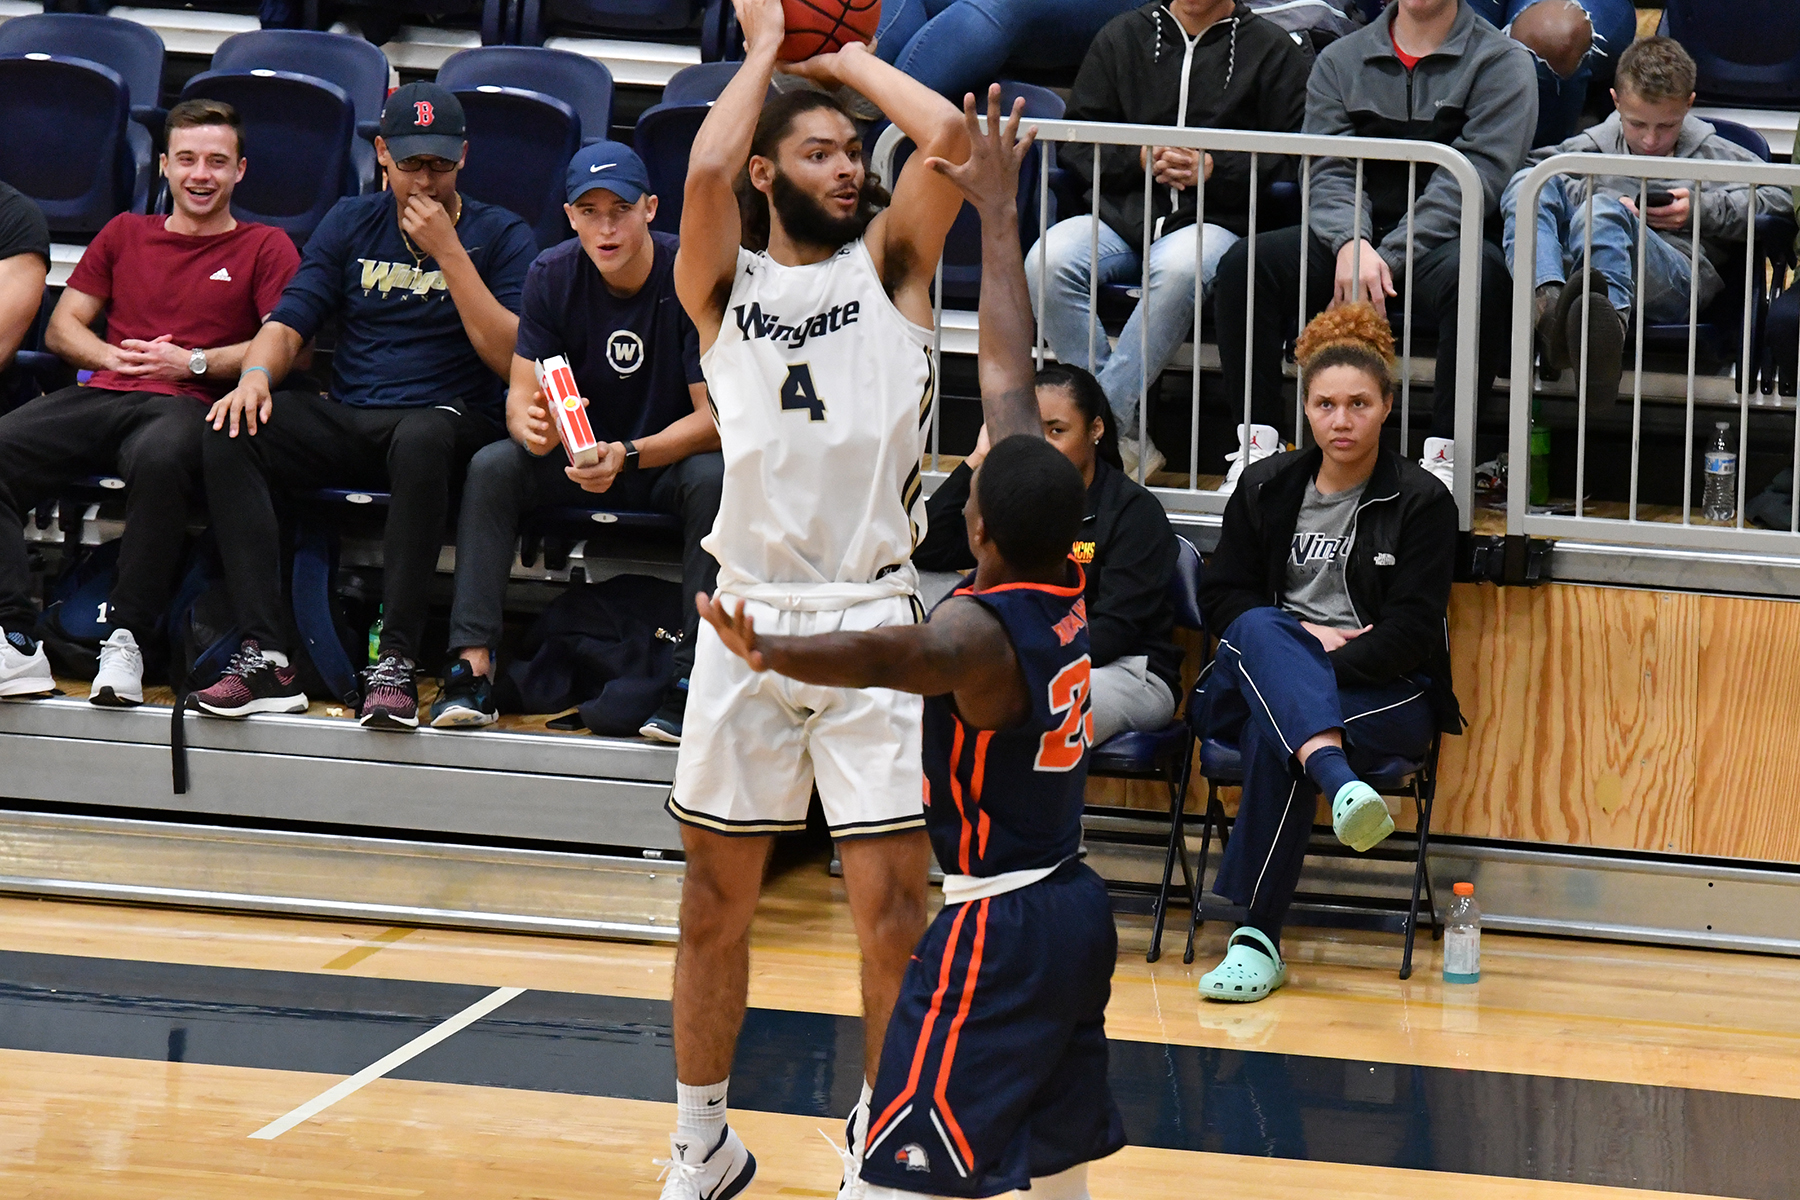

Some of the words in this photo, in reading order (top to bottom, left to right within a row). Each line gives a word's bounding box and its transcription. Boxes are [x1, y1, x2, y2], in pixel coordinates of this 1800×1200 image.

[413, 101, 435, 127] B
[357, 258, 449, 295] Winga
[732, 300, 860, 349] Wingate
[611, 342, 638, 361] W
[778, 360, 829, 423] 4
[1033, 653, 1095, 773] 2
